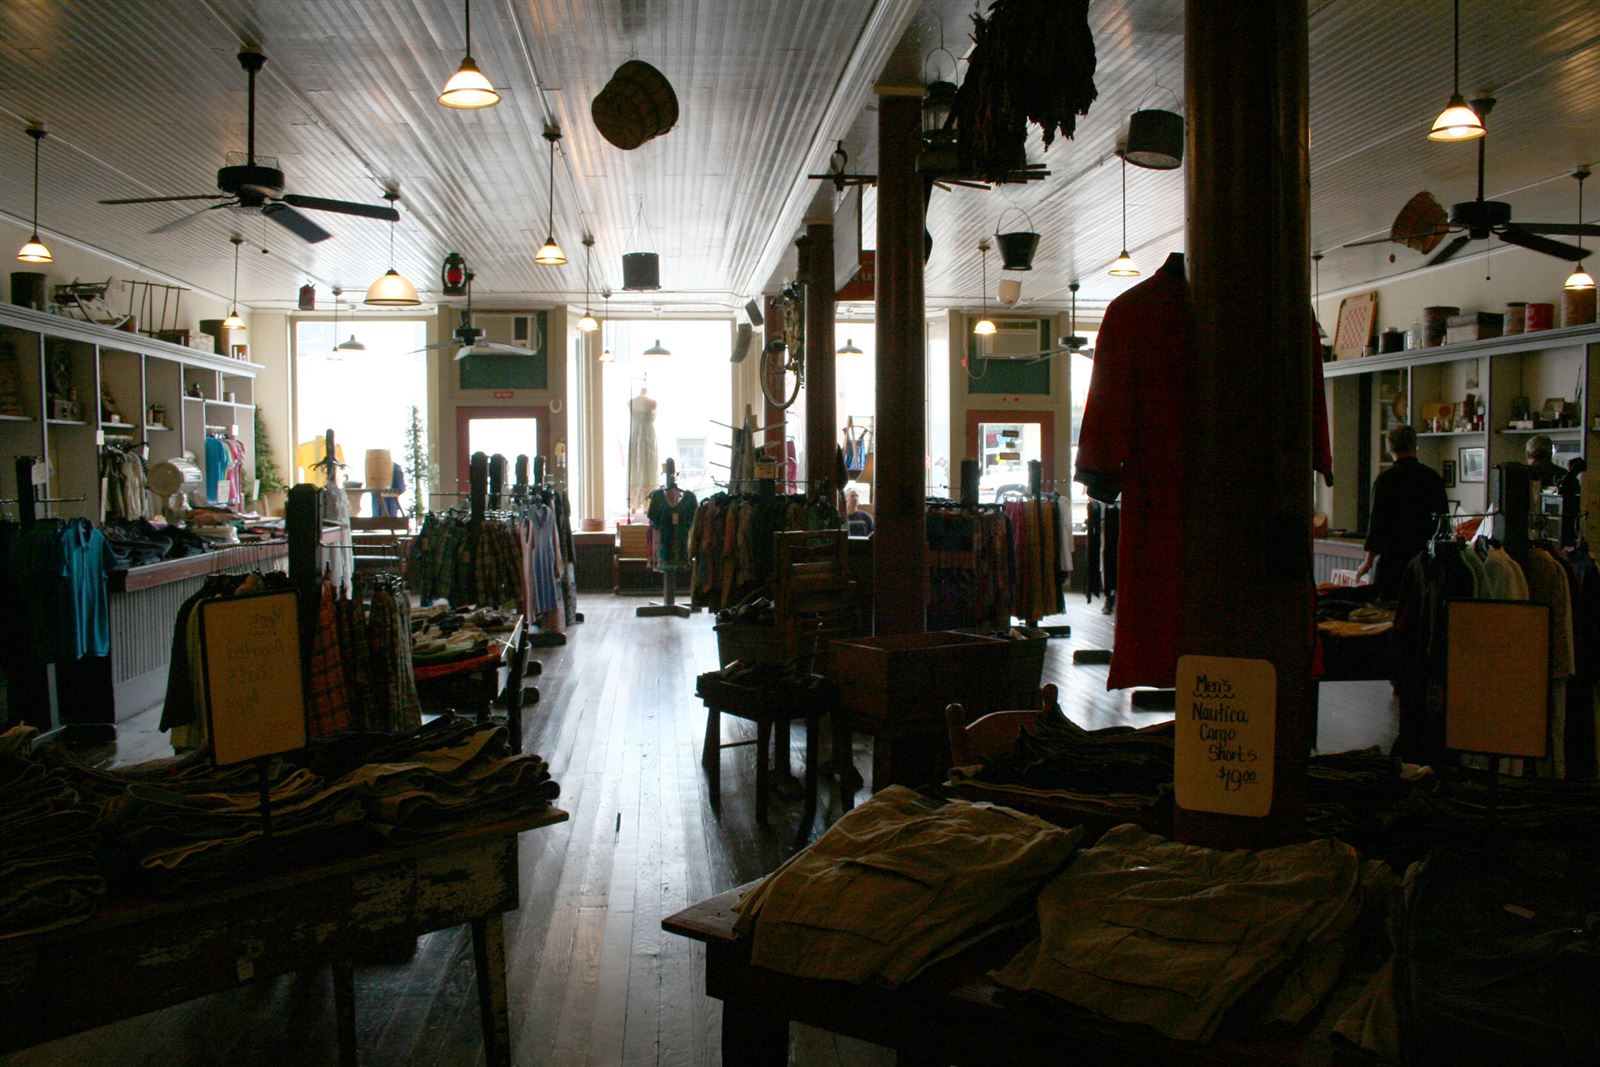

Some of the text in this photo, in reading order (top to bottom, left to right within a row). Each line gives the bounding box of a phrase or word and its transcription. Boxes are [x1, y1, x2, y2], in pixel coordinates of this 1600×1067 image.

[1195, 674, 1232, 693] Men's
[1192, 702, 1248, 723] Nautica
[1199, 723, 1236, 748] Cargo
[1208, 745, 1258, 762] Shorts
